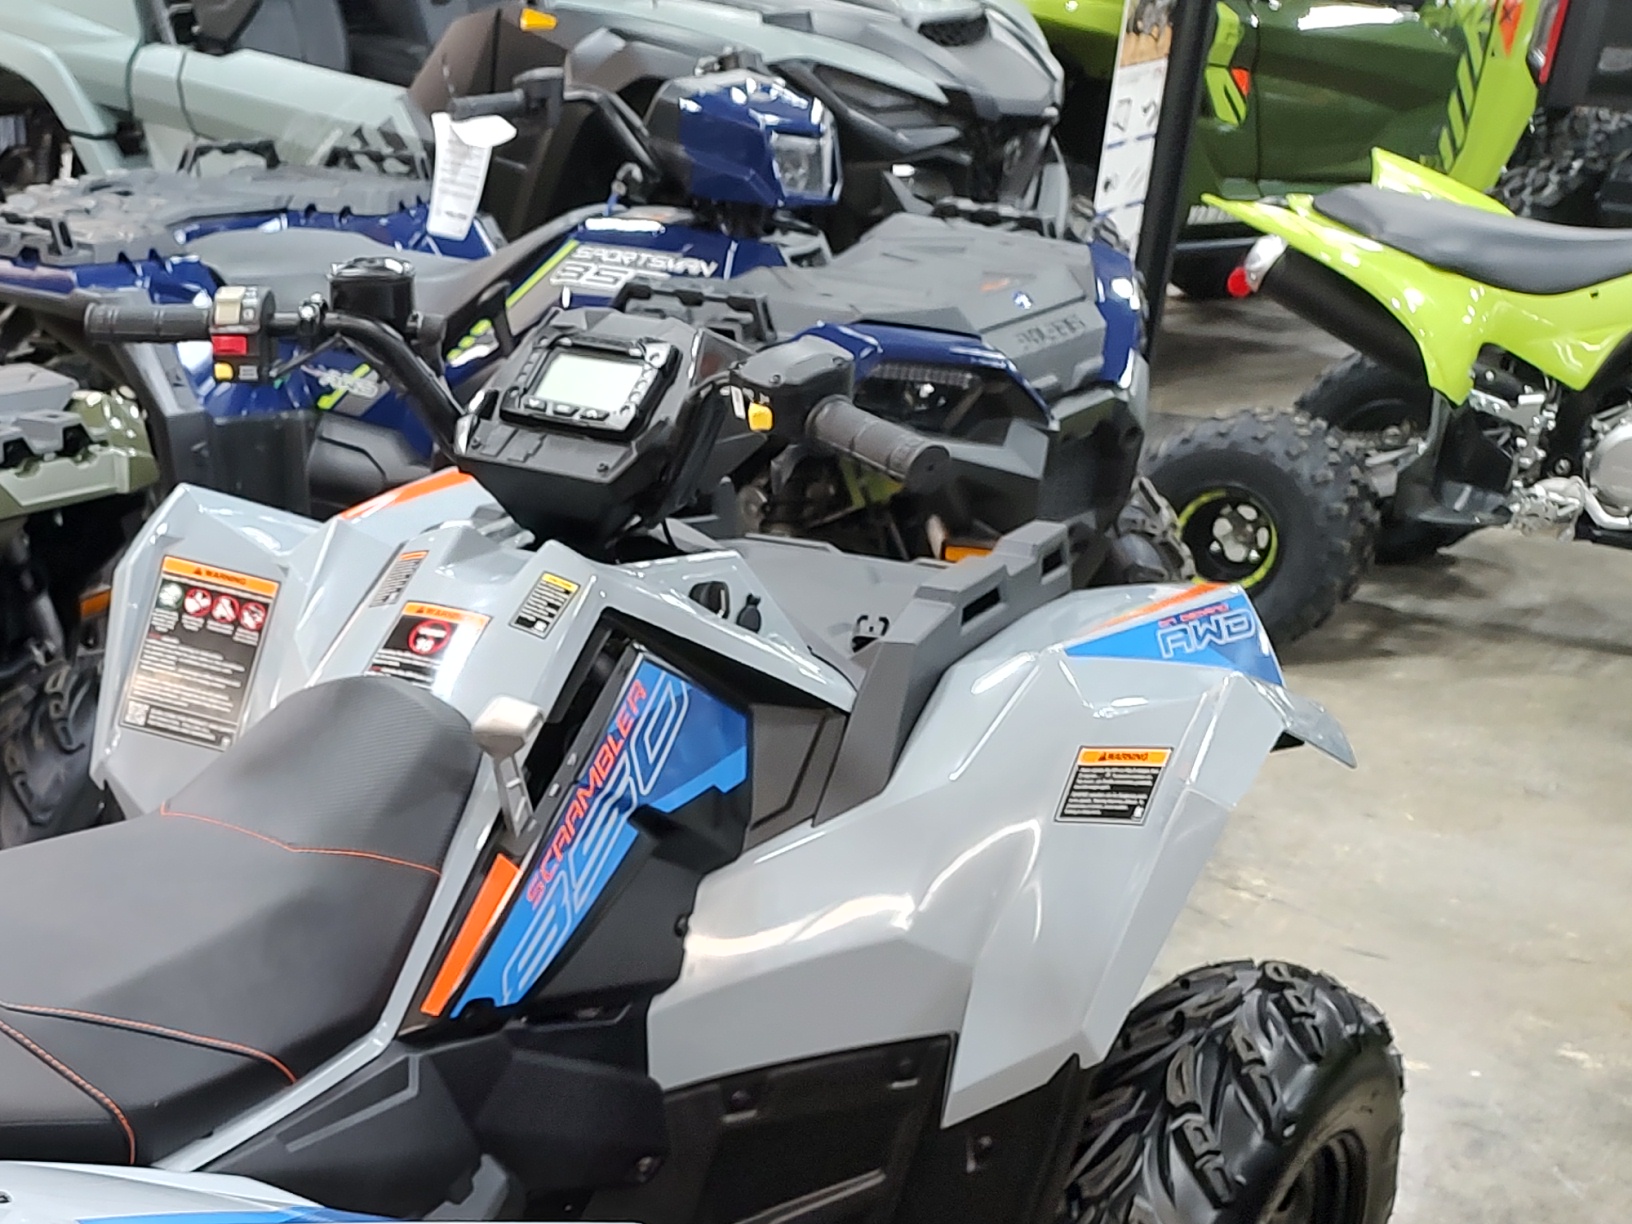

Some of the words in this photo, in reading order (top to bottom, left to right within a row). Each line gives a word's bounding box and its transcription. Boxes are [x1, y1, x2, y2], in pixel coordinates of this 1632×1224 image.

[572, 244, 719, 278] SPORTSMAN
[205, 569, 248, 586] WARNING
[1156, 608, 1256, 658] AWD
[1108, 752, 1149, 762] WARNING
[526, 678, 648, 911] SCRAMBLER
[501, 670, 690, 1006] 850
